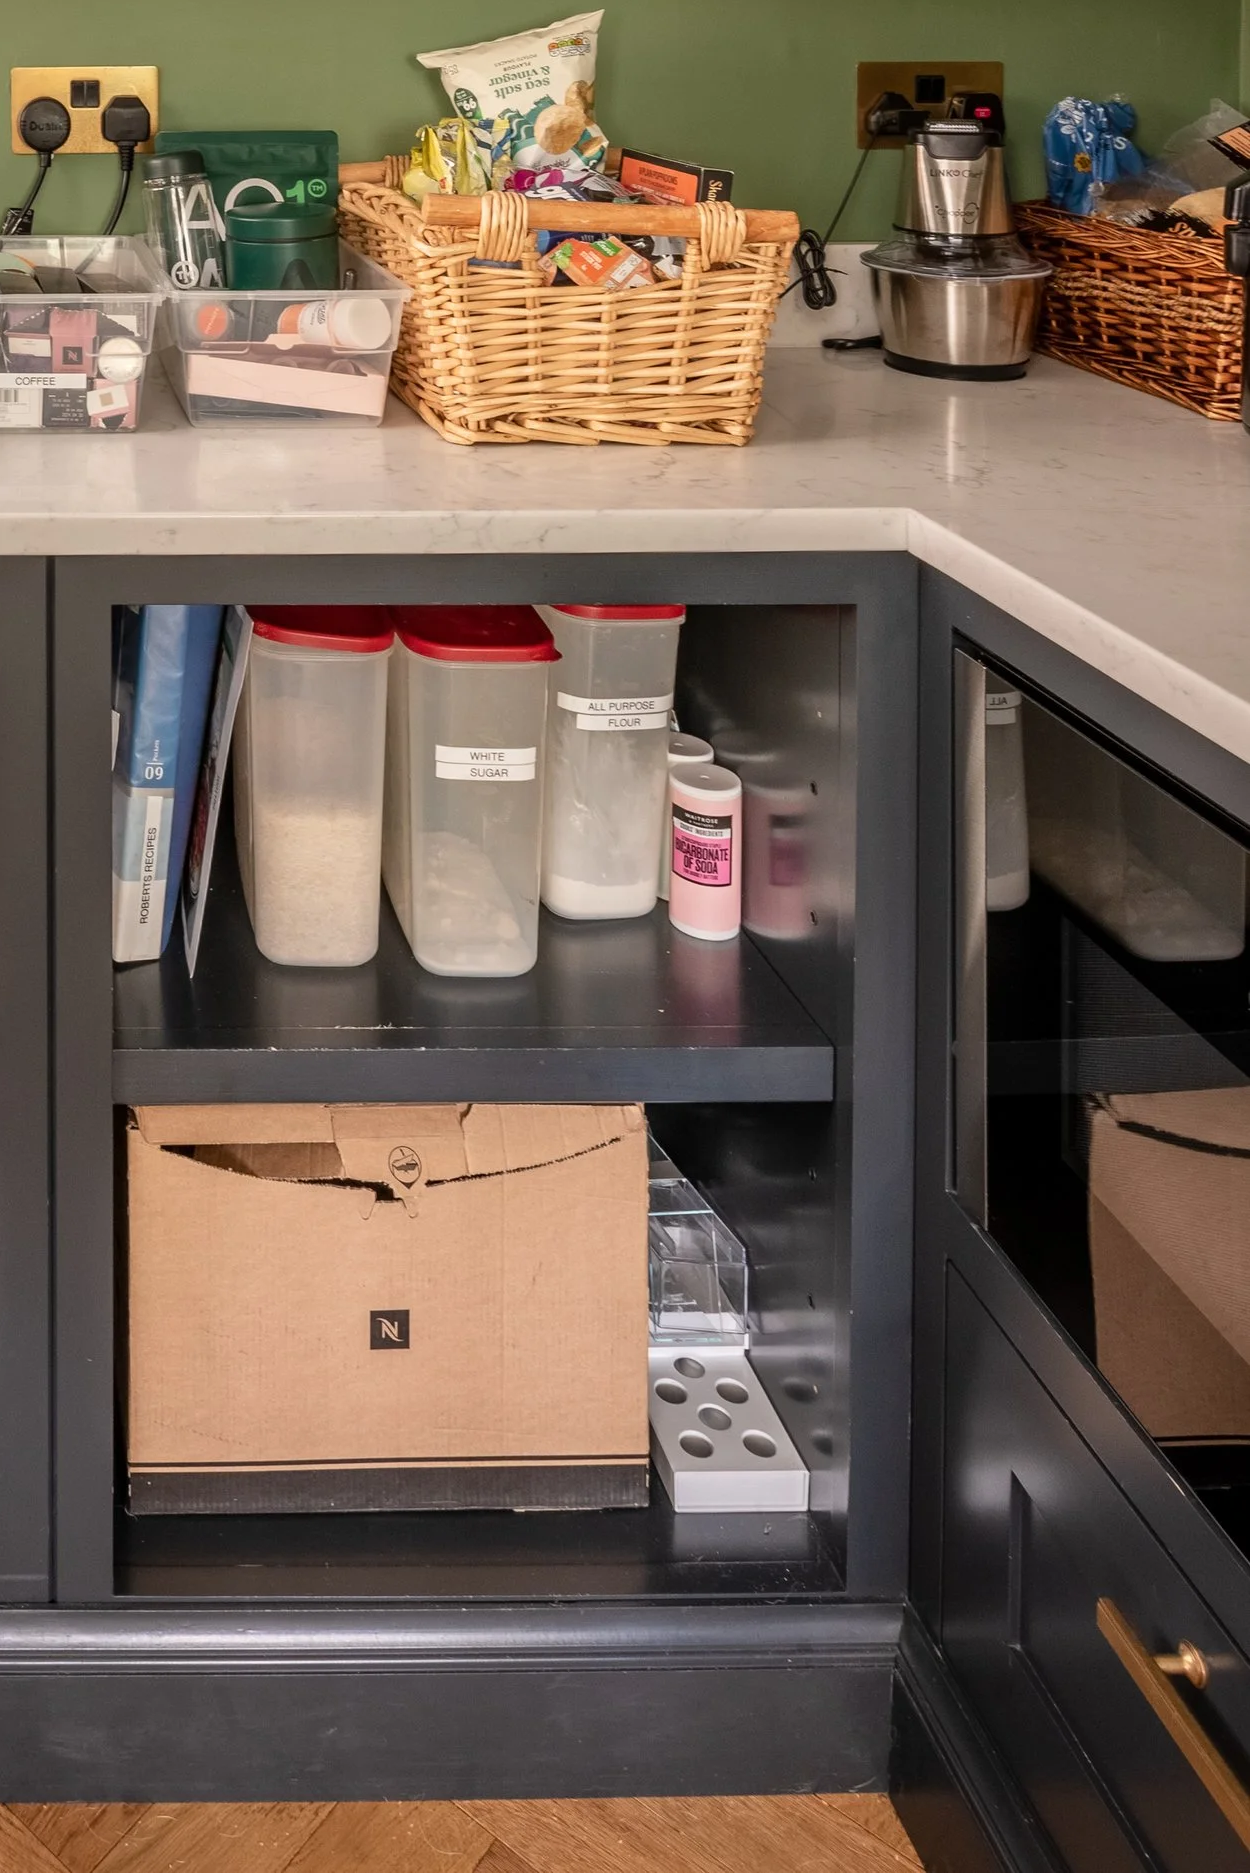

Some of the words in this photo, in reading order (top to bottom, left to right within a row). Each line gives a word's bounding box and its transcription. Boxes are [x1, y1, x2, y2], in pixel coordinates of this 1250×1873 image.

[494, 57, 515, 67] SNACKS
[518, 54, 537, 63] POTATO
[503, 61, 531, 71] FLAVOUR
[541, 65, 550, 76] &
[489, 69, 538, 88] vinegar
[525, 77, 550, 88] sea
[494, 83, 521, 99] salt
[15, 376, 56, 386] COFFEE
[587, 702, 606, 711] ALL
[609, 700, 656, 711] PURPOSE
[608, 717, 642, 727] FLOUR
[470, 752, 505, 762] WHITE
[144, 766, 164, 780] 09
[470, 768, 509, 778] SUGAR
[684, 812, 718, 825] WAITROSE
[144, 827, 158, 873] RECIPES
[675, 836, 730, 862] BICARBONATE
[683, 855, 693, 869] OF
[695, 859, 719, 874] SODA
[139, 874, 153, 924] ROBERTS
